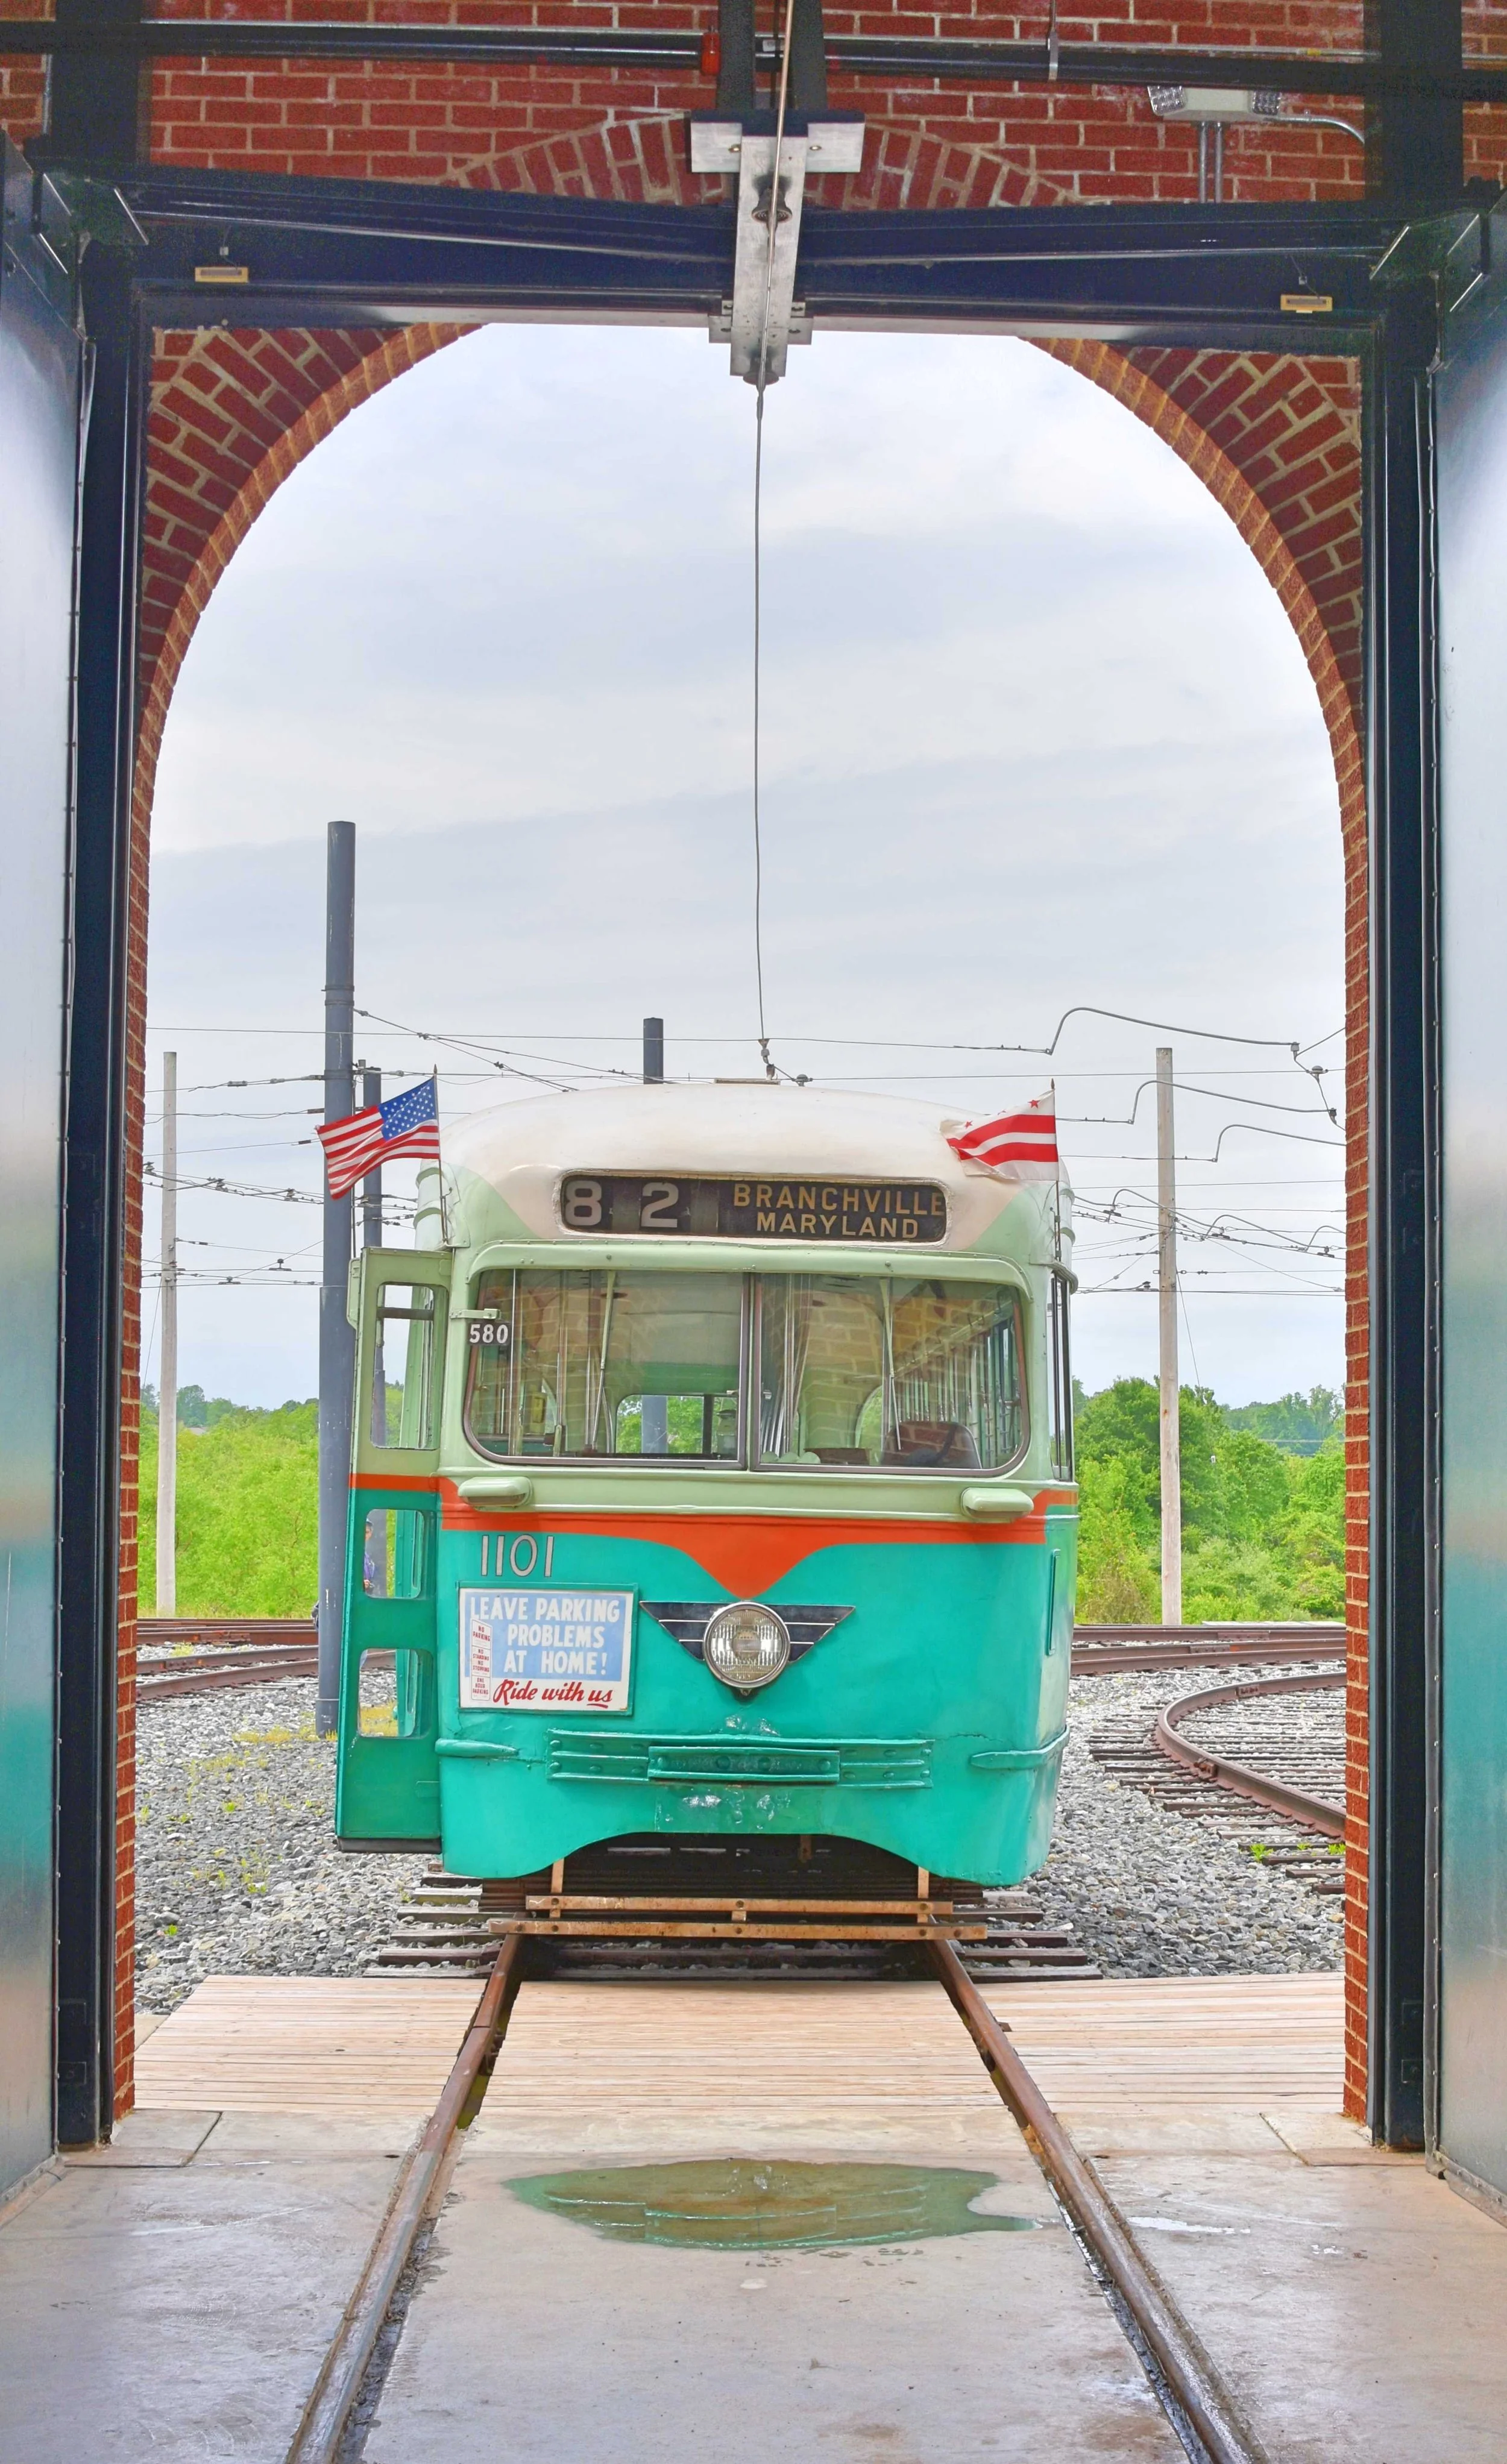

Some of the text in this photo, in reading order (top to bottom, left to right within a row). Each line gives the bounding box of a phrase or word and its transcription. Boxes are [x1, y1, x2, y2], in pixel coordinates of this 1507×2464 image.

[565, 1180, 679, 1228] 8 2
[733, 1183, 945, 1216] BRANCHVILLE
[757, 1212, 919, 1239] MARYLAND
[470, 1324, 508, 1344] 580
[481, 1533, 555, 1577] 1101
[470, 1597, 620, 1623] LEAVE PARKING
[473, 1630, 491, 1642] PARKING
[508, 1624, 605, 1648] PROBLEMS
[503, 1650, 608, 1675] AT HOME!
[493, 1679, 614, 1706] Ride with us
